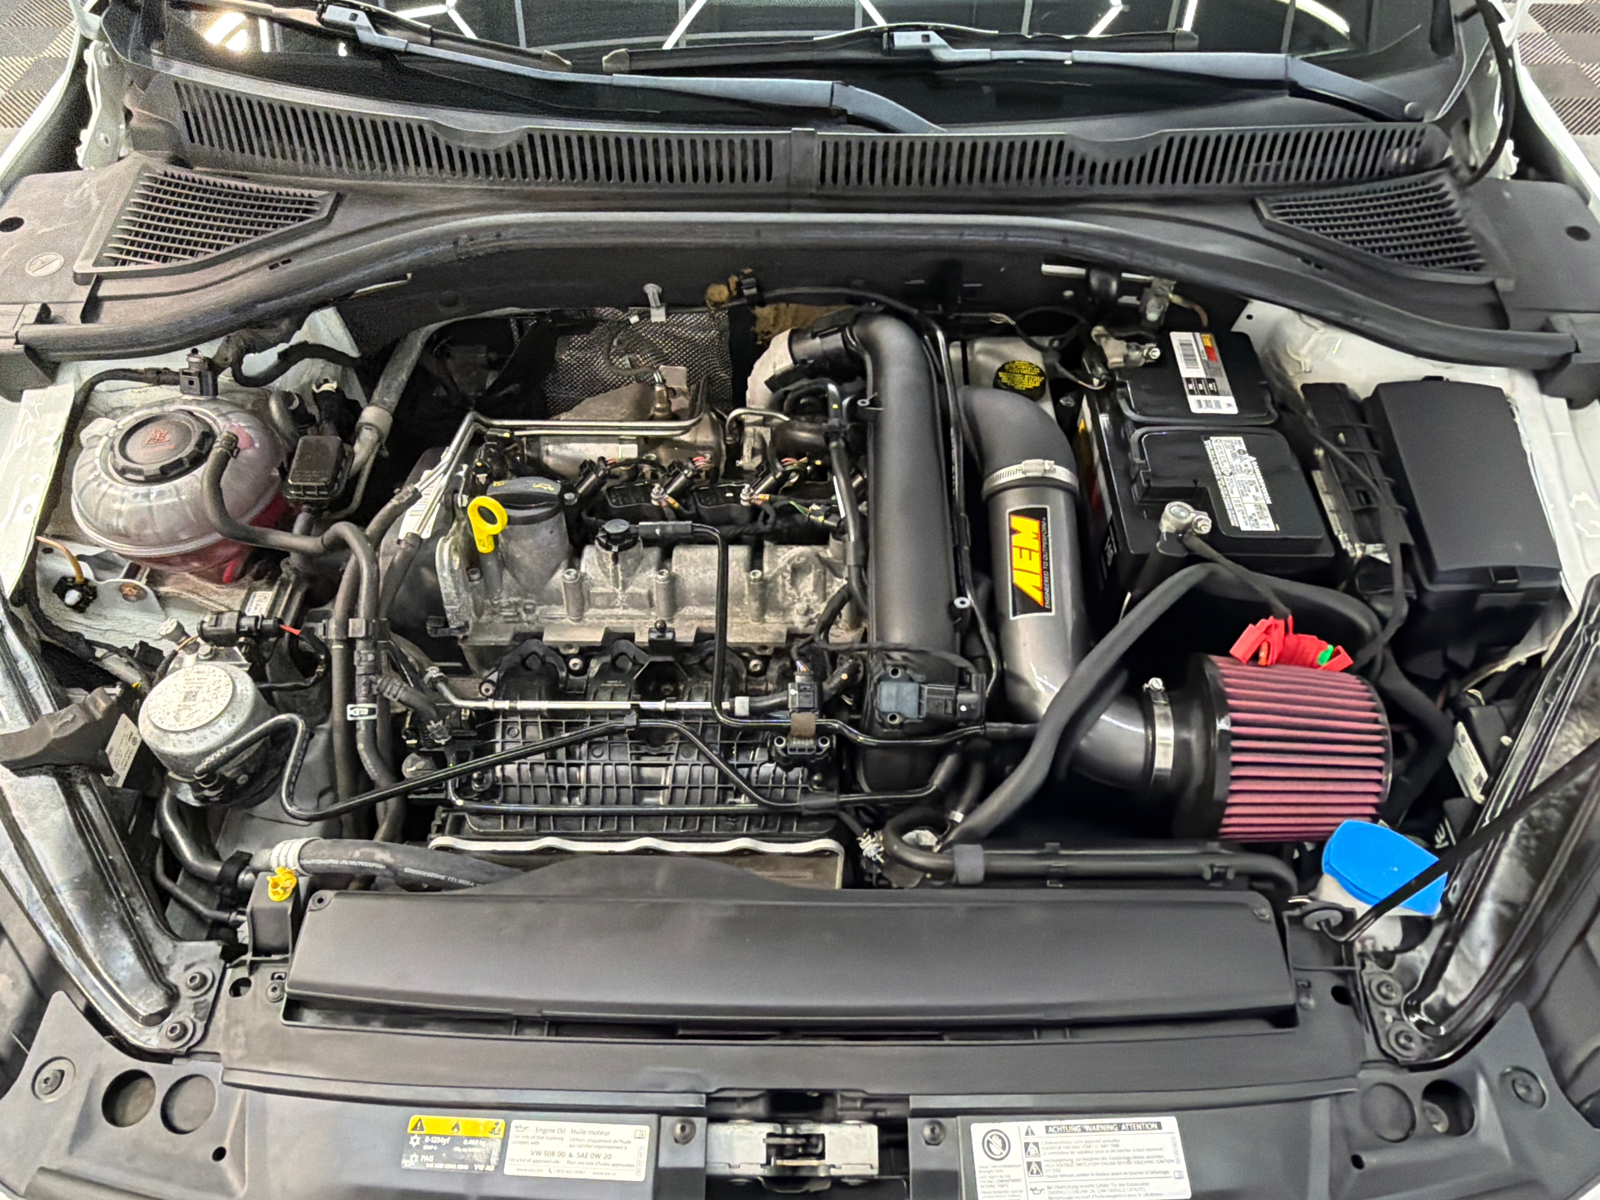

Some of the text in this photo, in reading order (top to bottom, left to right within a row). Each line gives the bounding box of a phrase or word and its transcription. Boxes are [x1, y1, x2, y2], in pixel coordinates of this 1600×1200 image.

[1010, 514, 1044, 607] AEM
[536, 1127, 555, 1135] Engine
[1048, 1122, 1158, 1133] ACHTUNG WARNING ATTENTION
[420, 1154, 434, 1162] PAG
